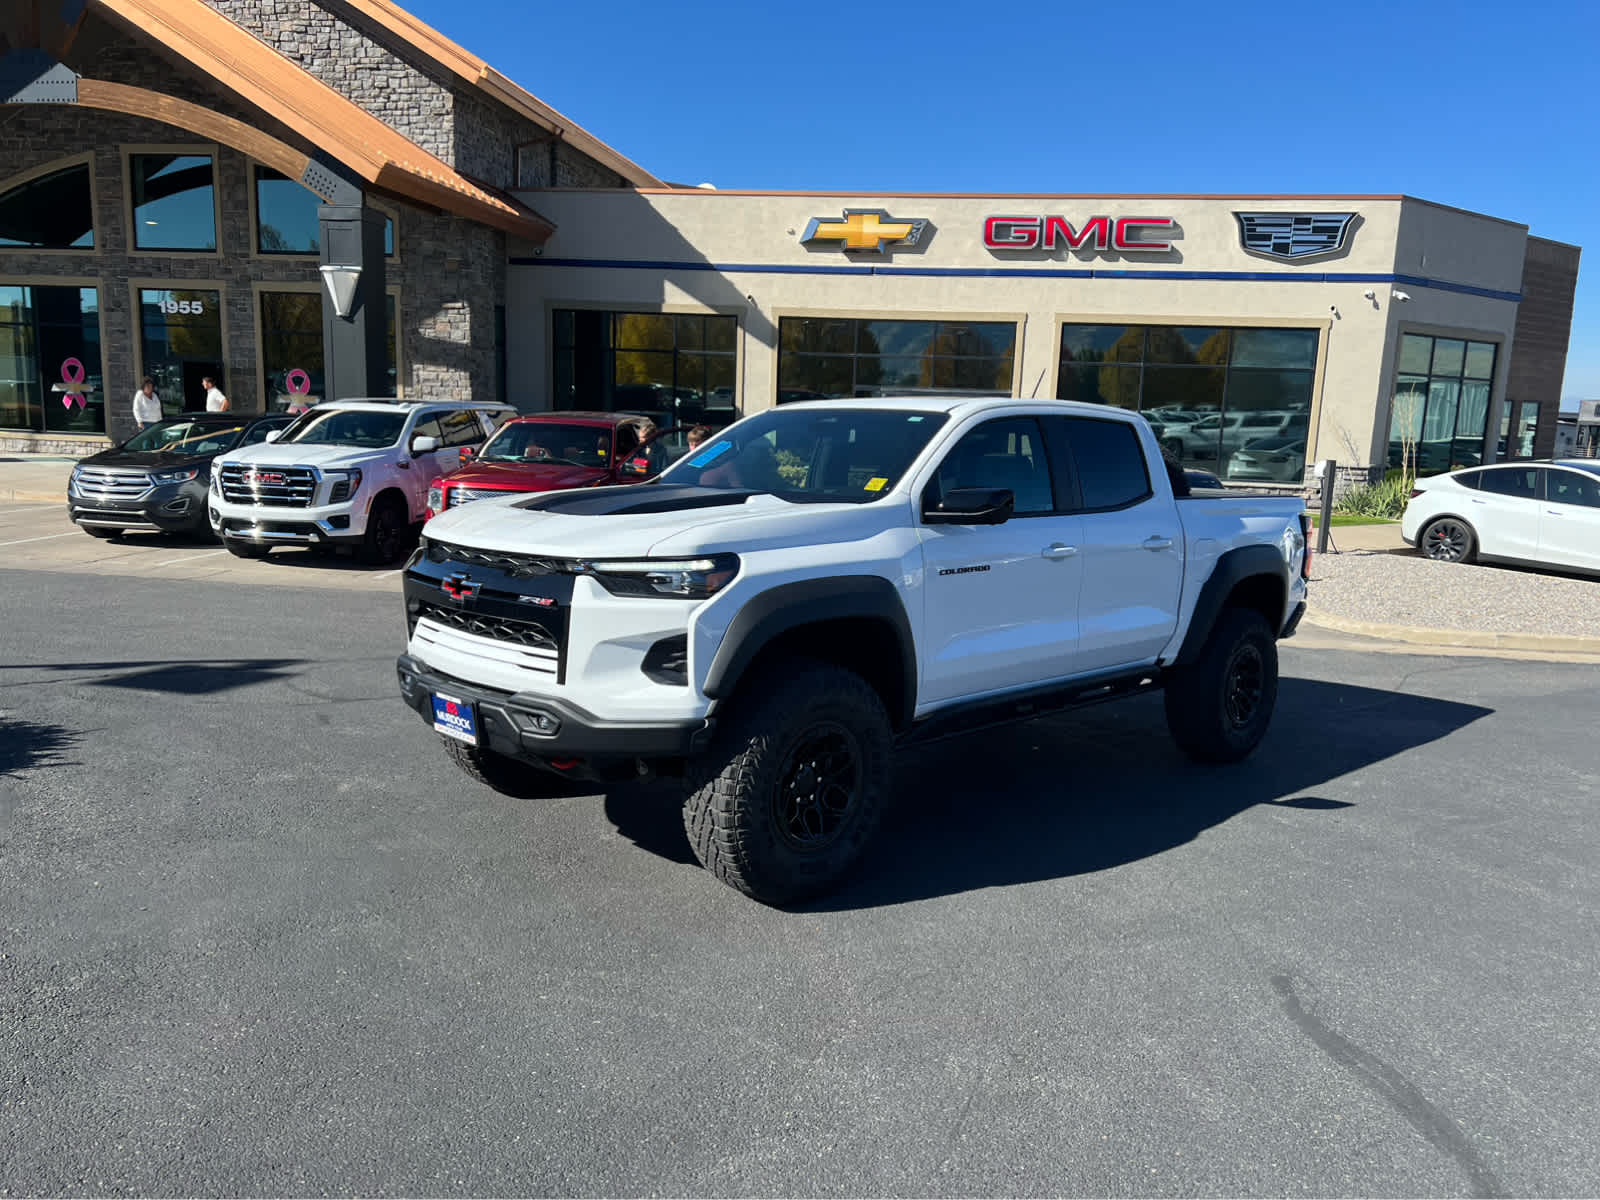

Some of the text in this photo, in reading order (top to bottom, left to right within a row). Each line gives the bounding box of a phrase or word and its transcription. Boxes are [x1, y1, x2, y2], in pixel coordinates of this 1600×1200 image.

[983, 215, 1174, 251] GMC
[158, 300, 203, 315] 1955
[939, 564, 991, 576] COLORADO
